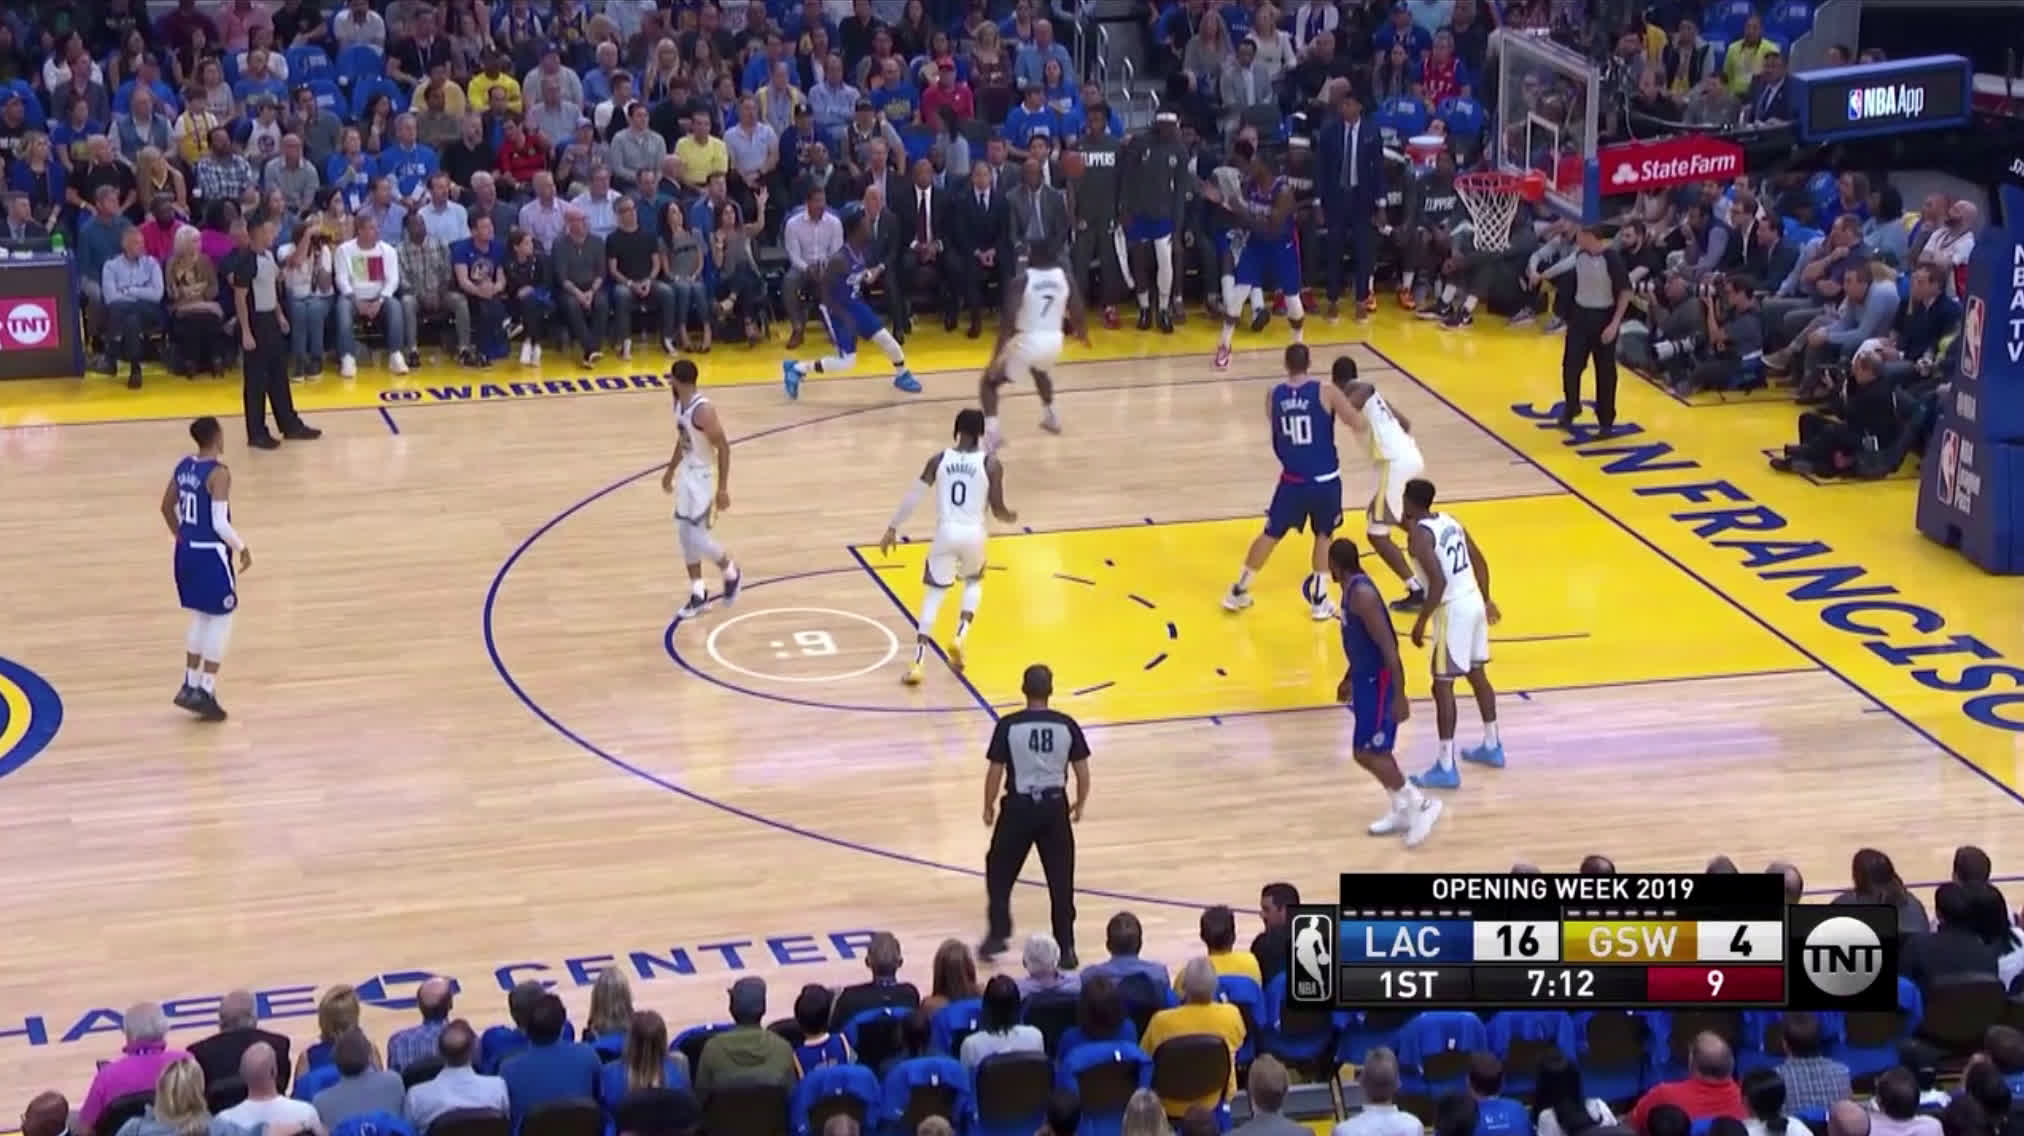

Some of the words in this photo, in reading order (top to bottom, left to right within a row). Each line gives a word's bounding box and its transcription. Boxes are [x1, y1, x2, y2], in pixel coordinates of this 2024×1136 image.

[1863, 87, 1896, 118] NBA
[1897, 84, 1924, 118] App
[1039, 296, 1053, 318] 7
[1281, 415, 1312, 446] 40
[951, 480, 966, 506] 0
[1447, 541, 1468, 575] 22
[1029, 728, 1053, 754] 48
